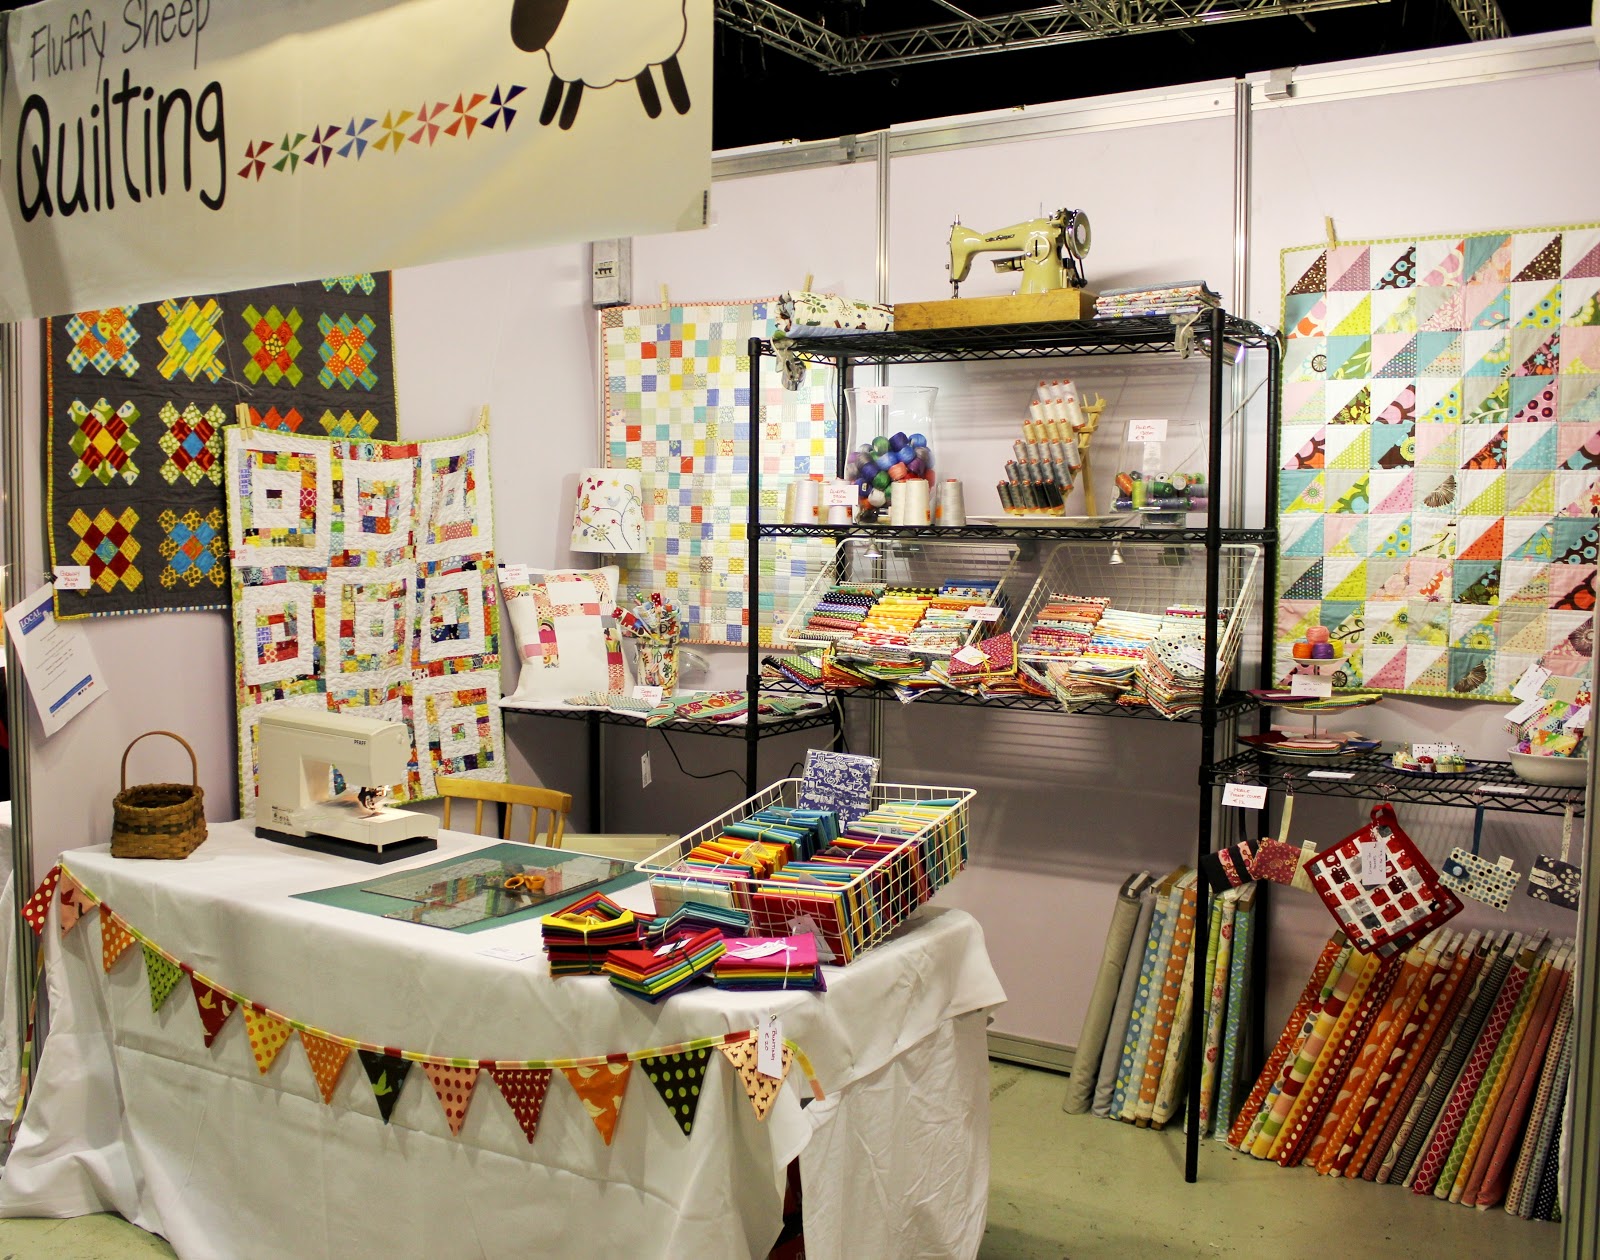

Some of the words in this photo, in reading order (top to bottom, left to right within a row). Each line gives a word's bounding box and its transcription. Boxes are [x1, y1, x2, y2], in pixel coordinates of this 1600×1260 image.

[31, 9, 106, 94] Fluffy
[122, 0, 210, 70] Sheep
[16, 68, 227, 223] Quilting
[20, 608, 42, 628] LOCAL
